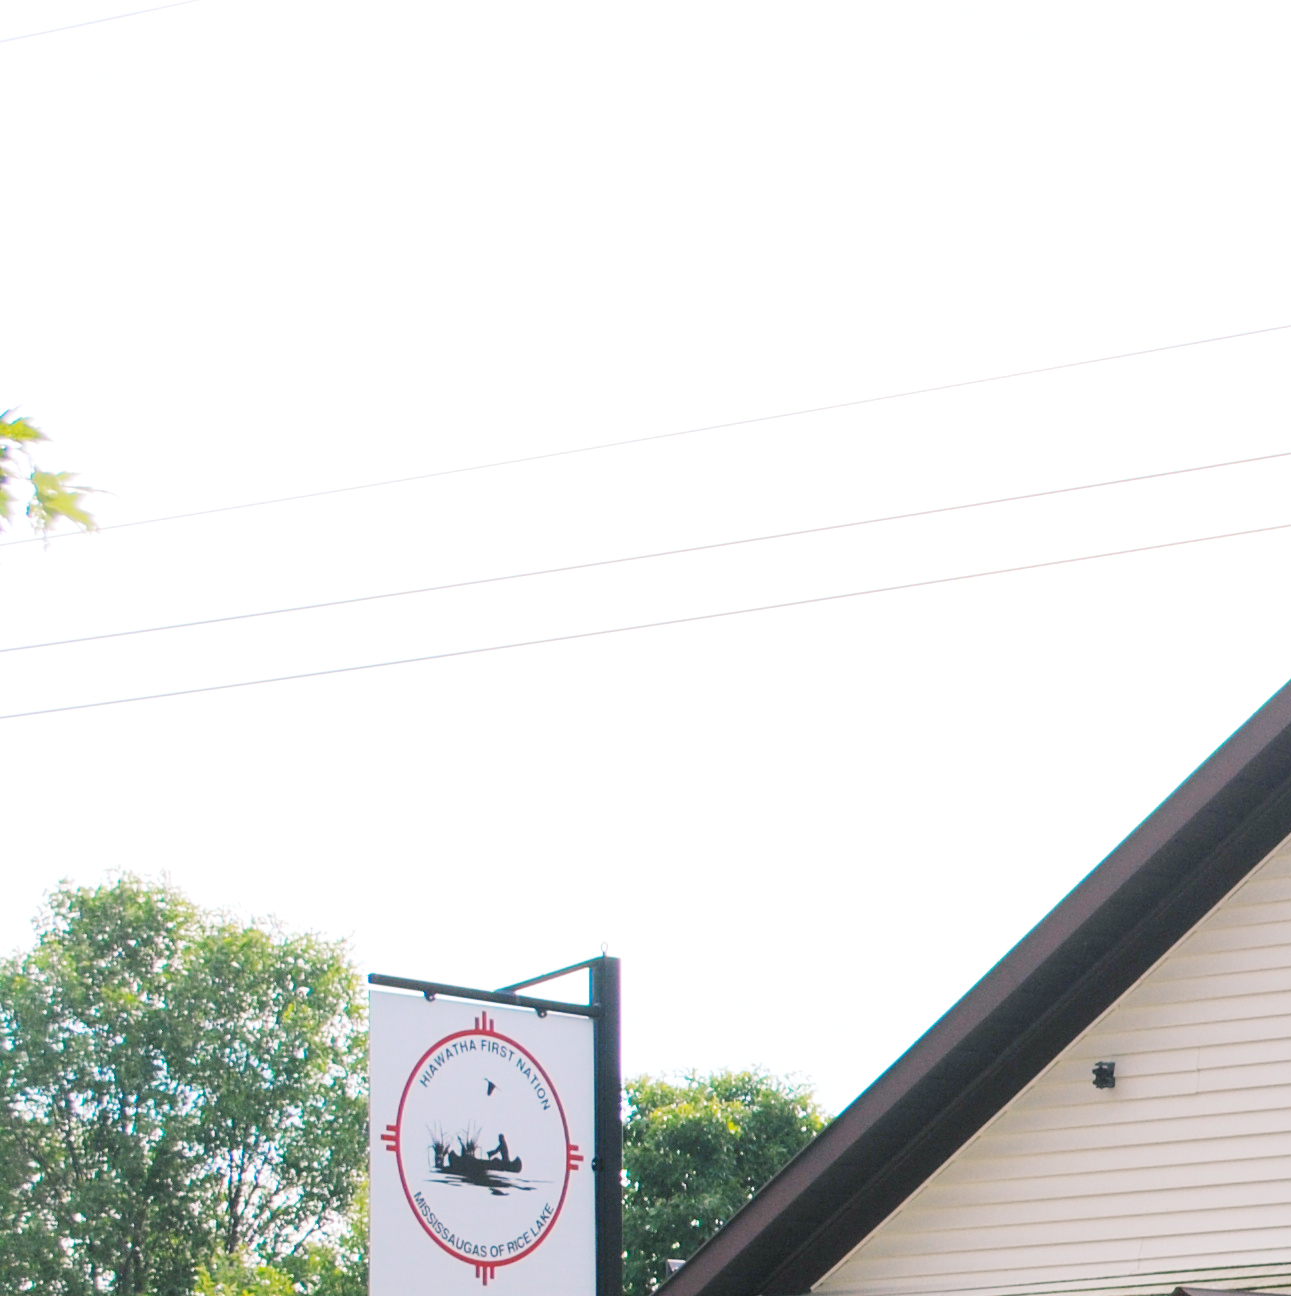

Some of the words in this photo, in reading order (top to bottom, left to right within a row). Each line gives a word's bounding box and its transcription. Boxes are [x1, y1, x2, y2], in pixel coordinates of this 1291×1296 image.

[419, 1040, 477, 1088] HIAWATHA
[481, 1040, 514, 1062] FIRST
[516, 1057, 551, 1112] NATION
[413, 1191, 488, 1258] MISSISSAUGAS
[490, 1244, 505, 1258] OF
[507, 1231, 531, 1256] RICE
[530, 1201, 554, 1234] LAKE
